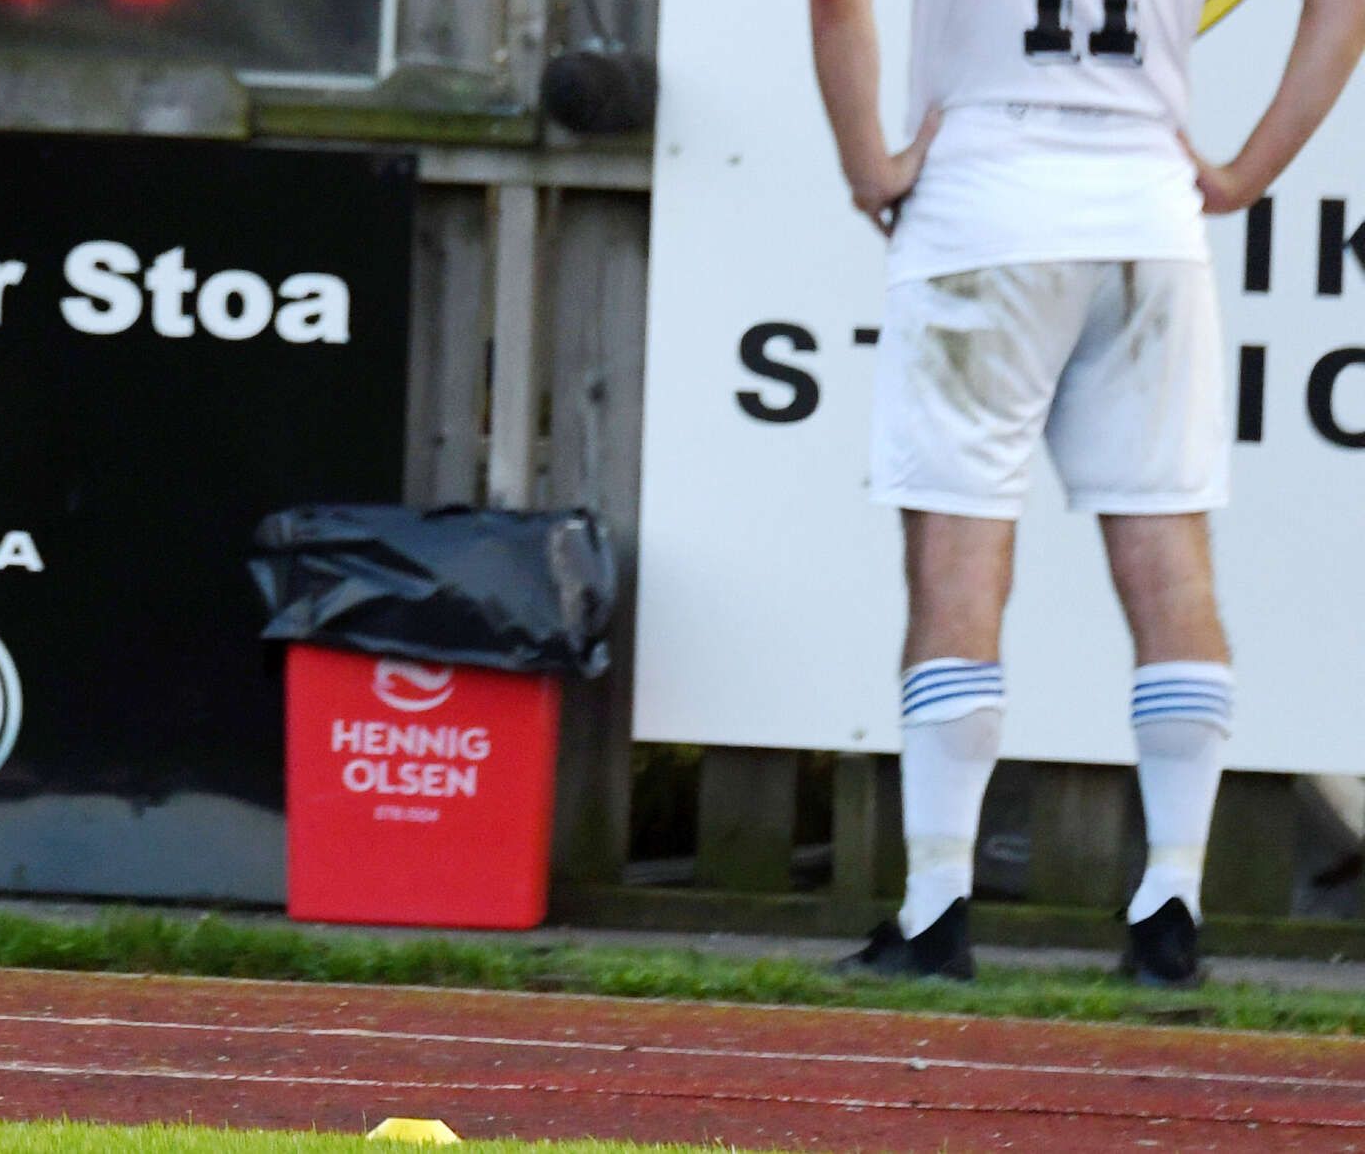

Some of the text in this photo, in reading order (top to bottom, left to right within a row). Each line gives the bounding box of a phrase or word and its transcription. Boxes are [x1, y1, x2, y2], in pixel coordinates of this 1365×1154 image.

[60, 239, 350, 345] Stoa
[331, 719, 491, 761] HENNIG
[342, 758, 478, 797] OLSEN
